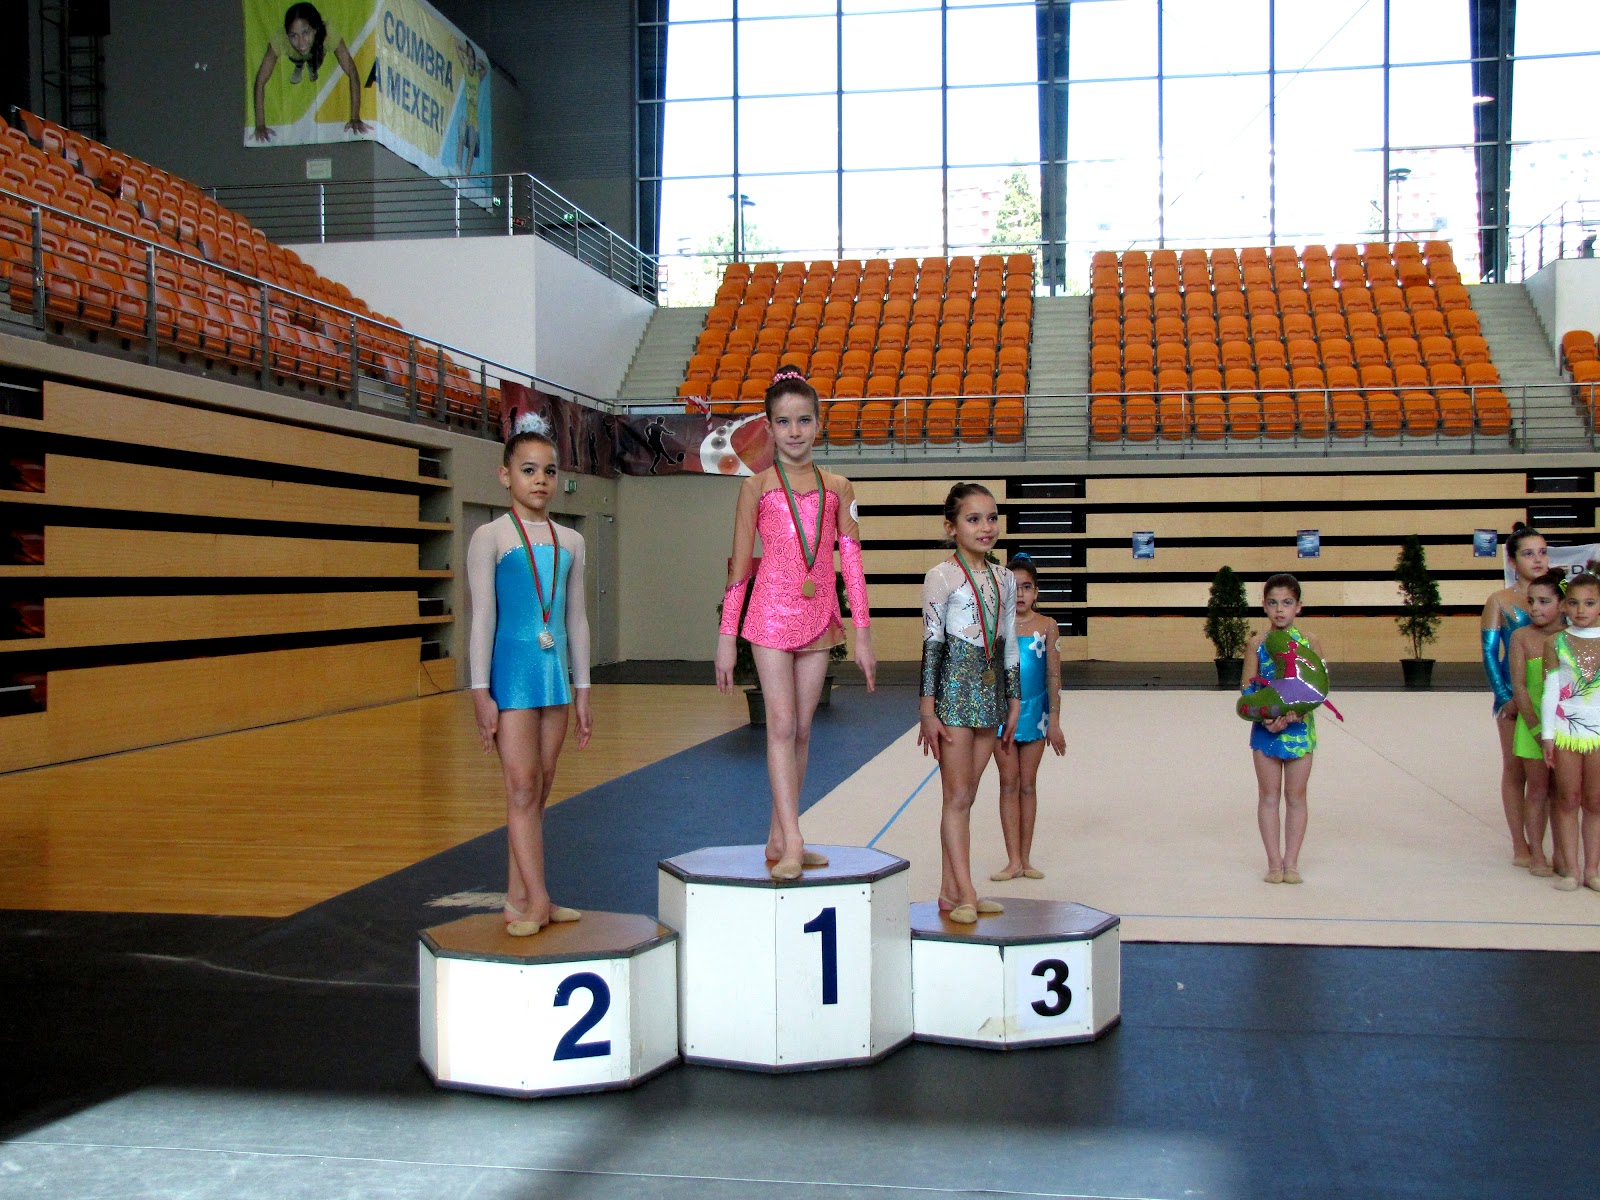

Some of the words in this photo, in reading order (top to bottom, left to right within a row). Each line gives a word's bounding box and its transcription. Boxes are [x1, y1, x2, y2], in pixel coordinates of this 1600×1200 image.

[383, 10, 454, 92] COIMBRA
[364, 56, 382, 93] A
[387, 68, 445, 137] MEXER!
[803, 907, 838, 1005] 1
[1030, 959, 1073, 1017] 3
[553, 972, 611, 1060] 2
